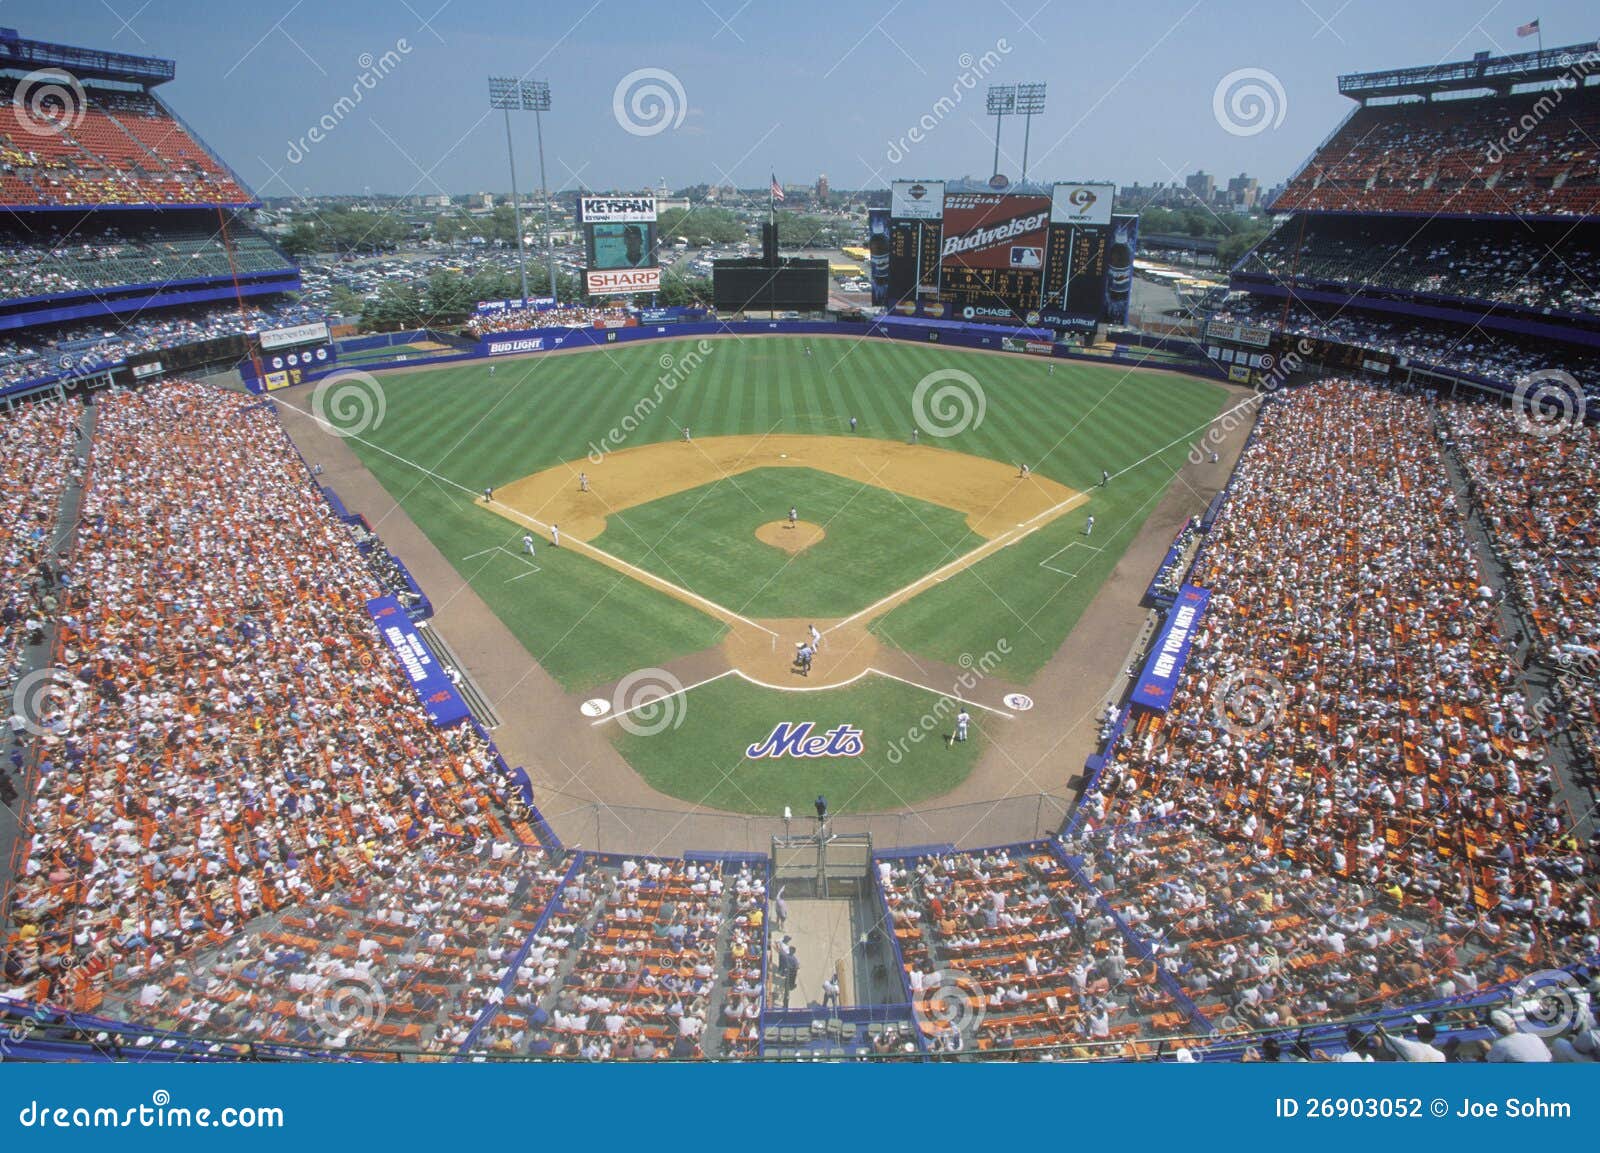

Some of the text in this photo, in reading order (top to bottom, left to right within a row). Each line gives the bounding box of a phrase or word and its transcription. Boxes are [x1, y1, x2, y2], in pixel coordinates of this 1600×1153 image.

[585, 199, 654, 213] KEYSPAN
[942, 212, 1049, 256] Budweiser
[589, 272, 659, 287] SHARP
[975, 307, 1012, 317] CHASE
[490, 342, 512, 353] BUD
[512, 339, 541, 351] LIGHT
[385, 626, 428, 682] SHEA STADIUM
[1152, 605, 1196, 678] NEW YORK METS
[746, 721, 864, 759] Mets
